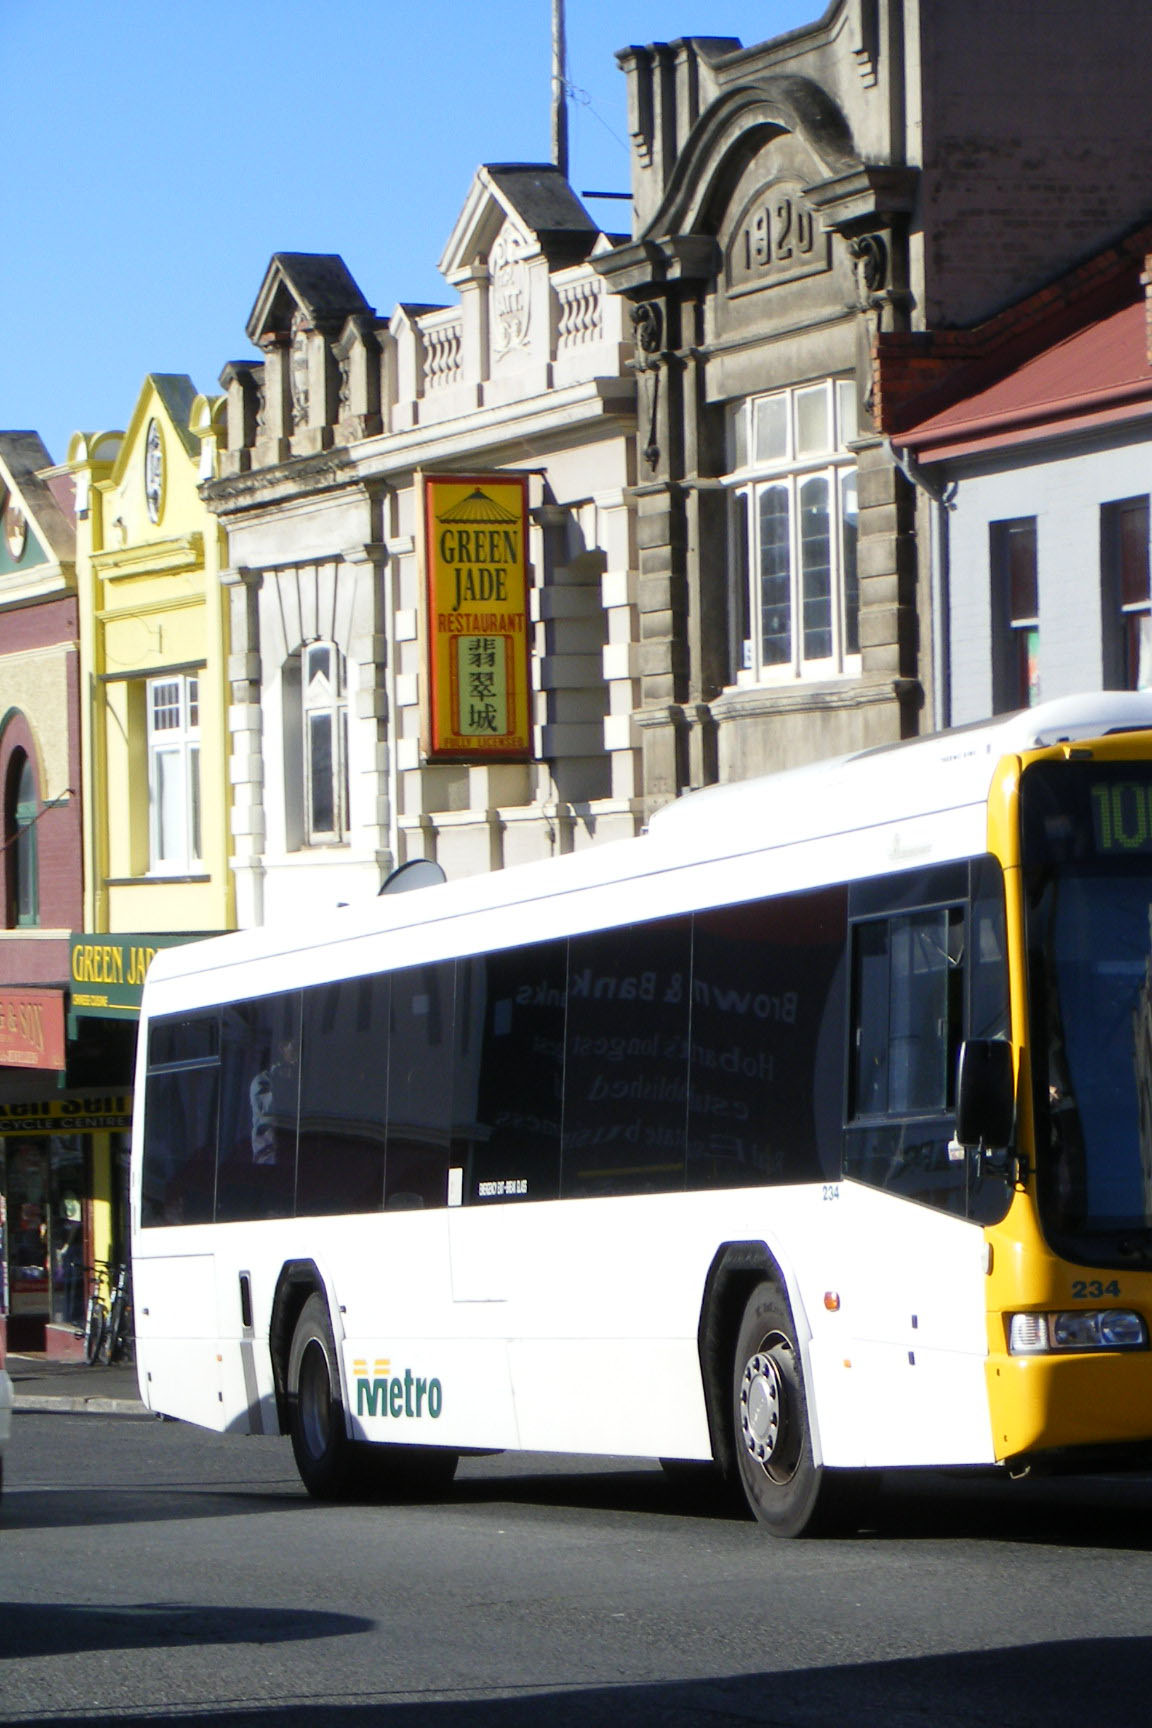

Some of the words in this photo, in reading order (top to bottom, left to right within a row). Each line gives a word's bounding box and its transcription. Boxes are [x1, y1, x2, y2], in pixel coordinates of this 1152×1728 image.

[743, 198, 814, 270] 1920
[440, 530, 518, 564] GREEN
[453, 568, 507, 612] JADE
[438, 613, 525, 633] RESTAURANT
[469, 638, 498, 732] 翡翠城
[72, 945, 124, 984] GREEN
[823, 1185, 840, 1201] 234
[1072, 1280, 1121, 1299] 234
